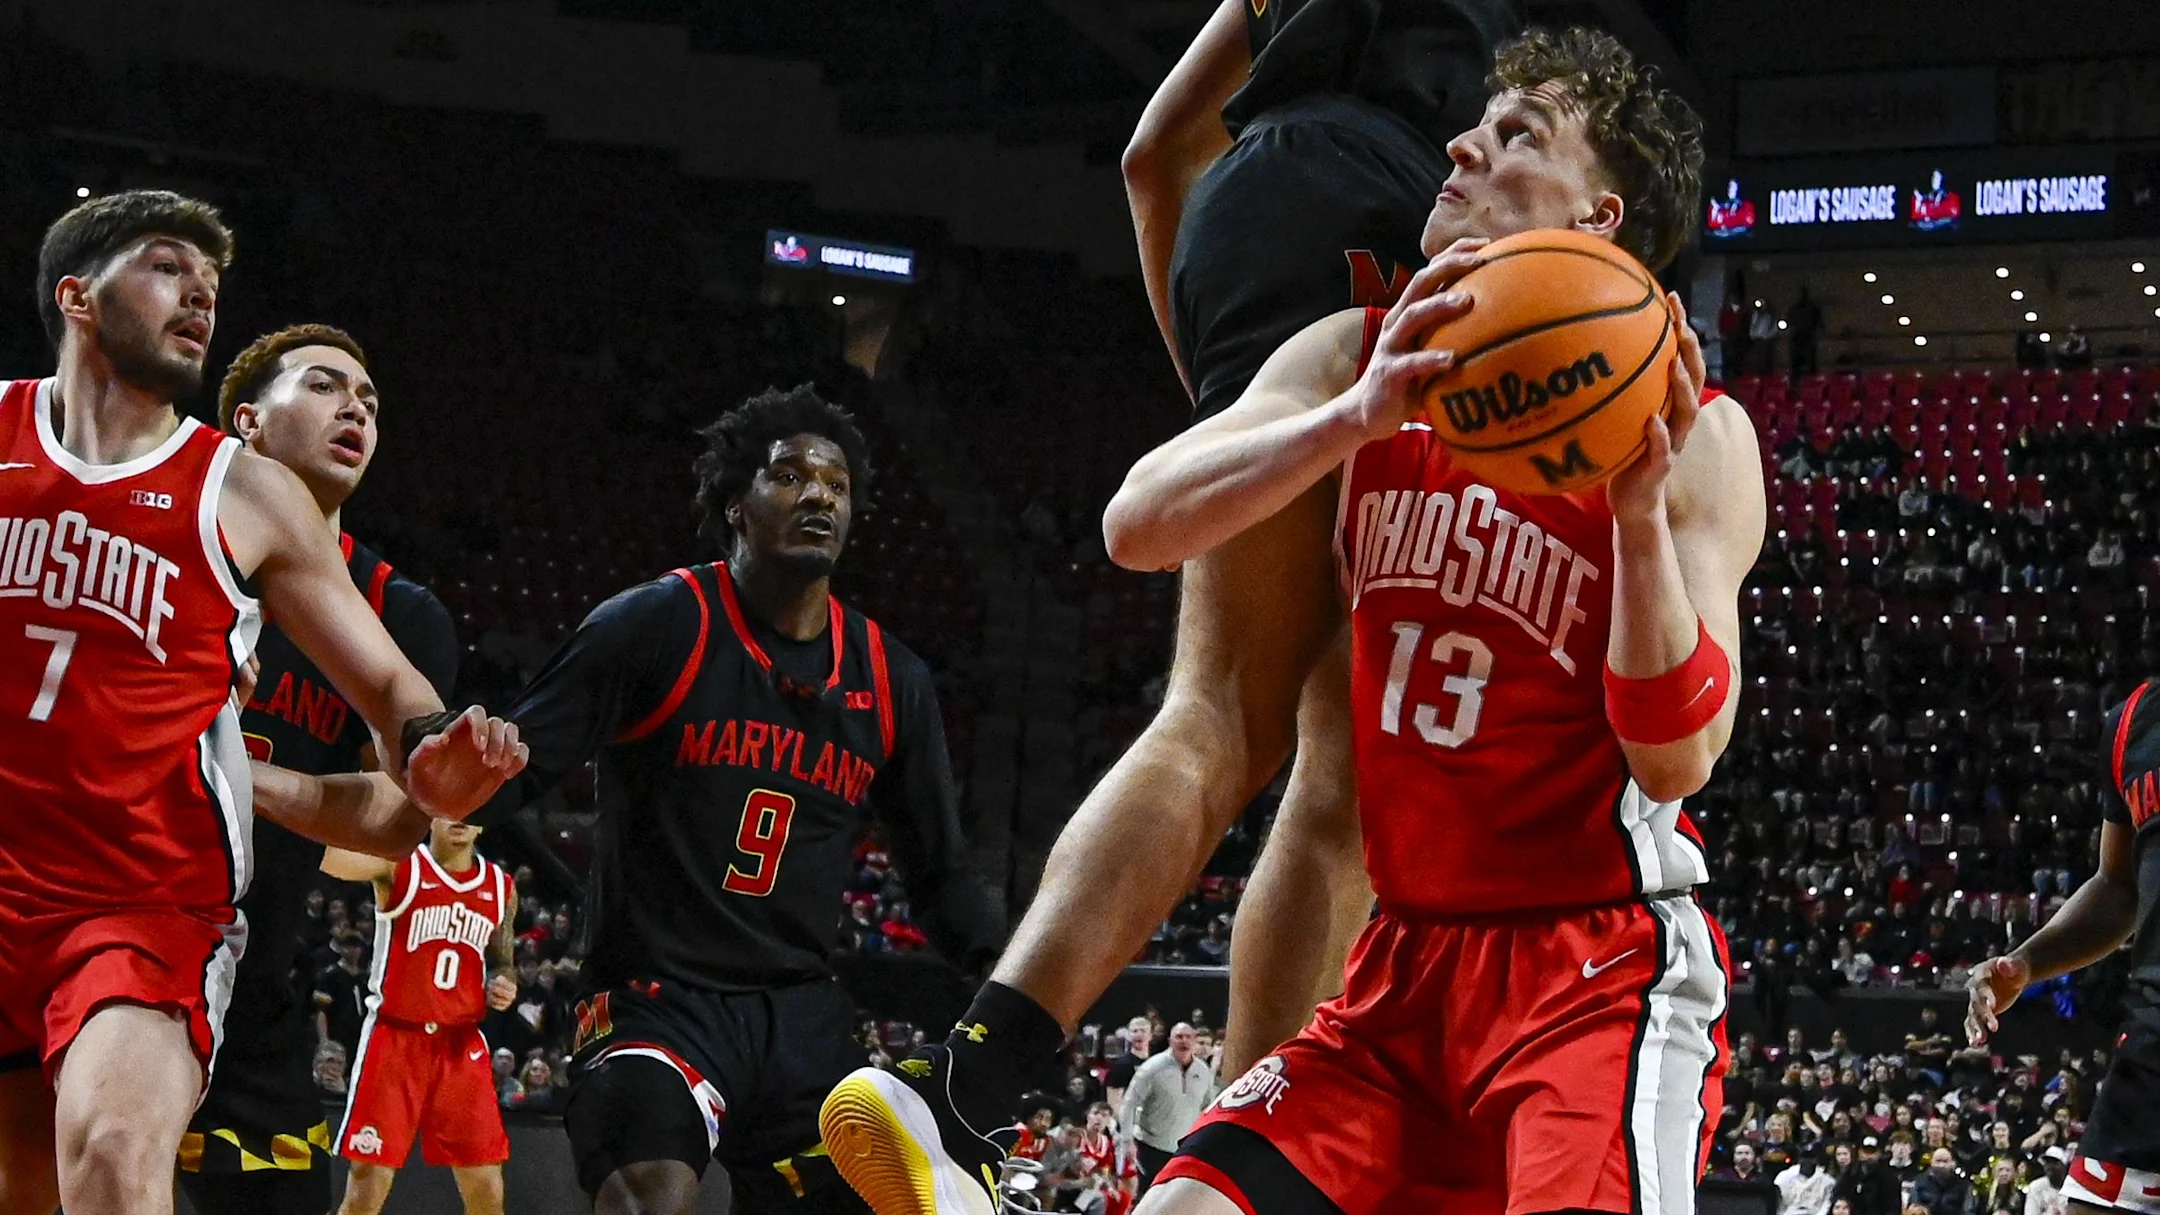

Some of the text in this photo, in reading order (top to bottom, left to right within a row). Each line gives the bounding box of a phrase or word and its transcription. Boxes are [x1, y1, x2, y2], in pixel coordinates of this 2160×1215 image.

[1770, 185, 1896, 224] LOGAN'S SAUSAGE
[1975, 175, 2107, 215] LOGAN'S SAUSAGE
[1440, 351, 1614, 433] Wilson
[1530, 438, 1600, 485] M
[43, 509, 181, 666] STATE
[25, 623, 78, 723] 7
[1380, 620, 1494, 749] 13
[675, 718, 876, 807] MARYLAND
[721, 788, 796, 897] 9
[433, 949, 460, 991] 0
